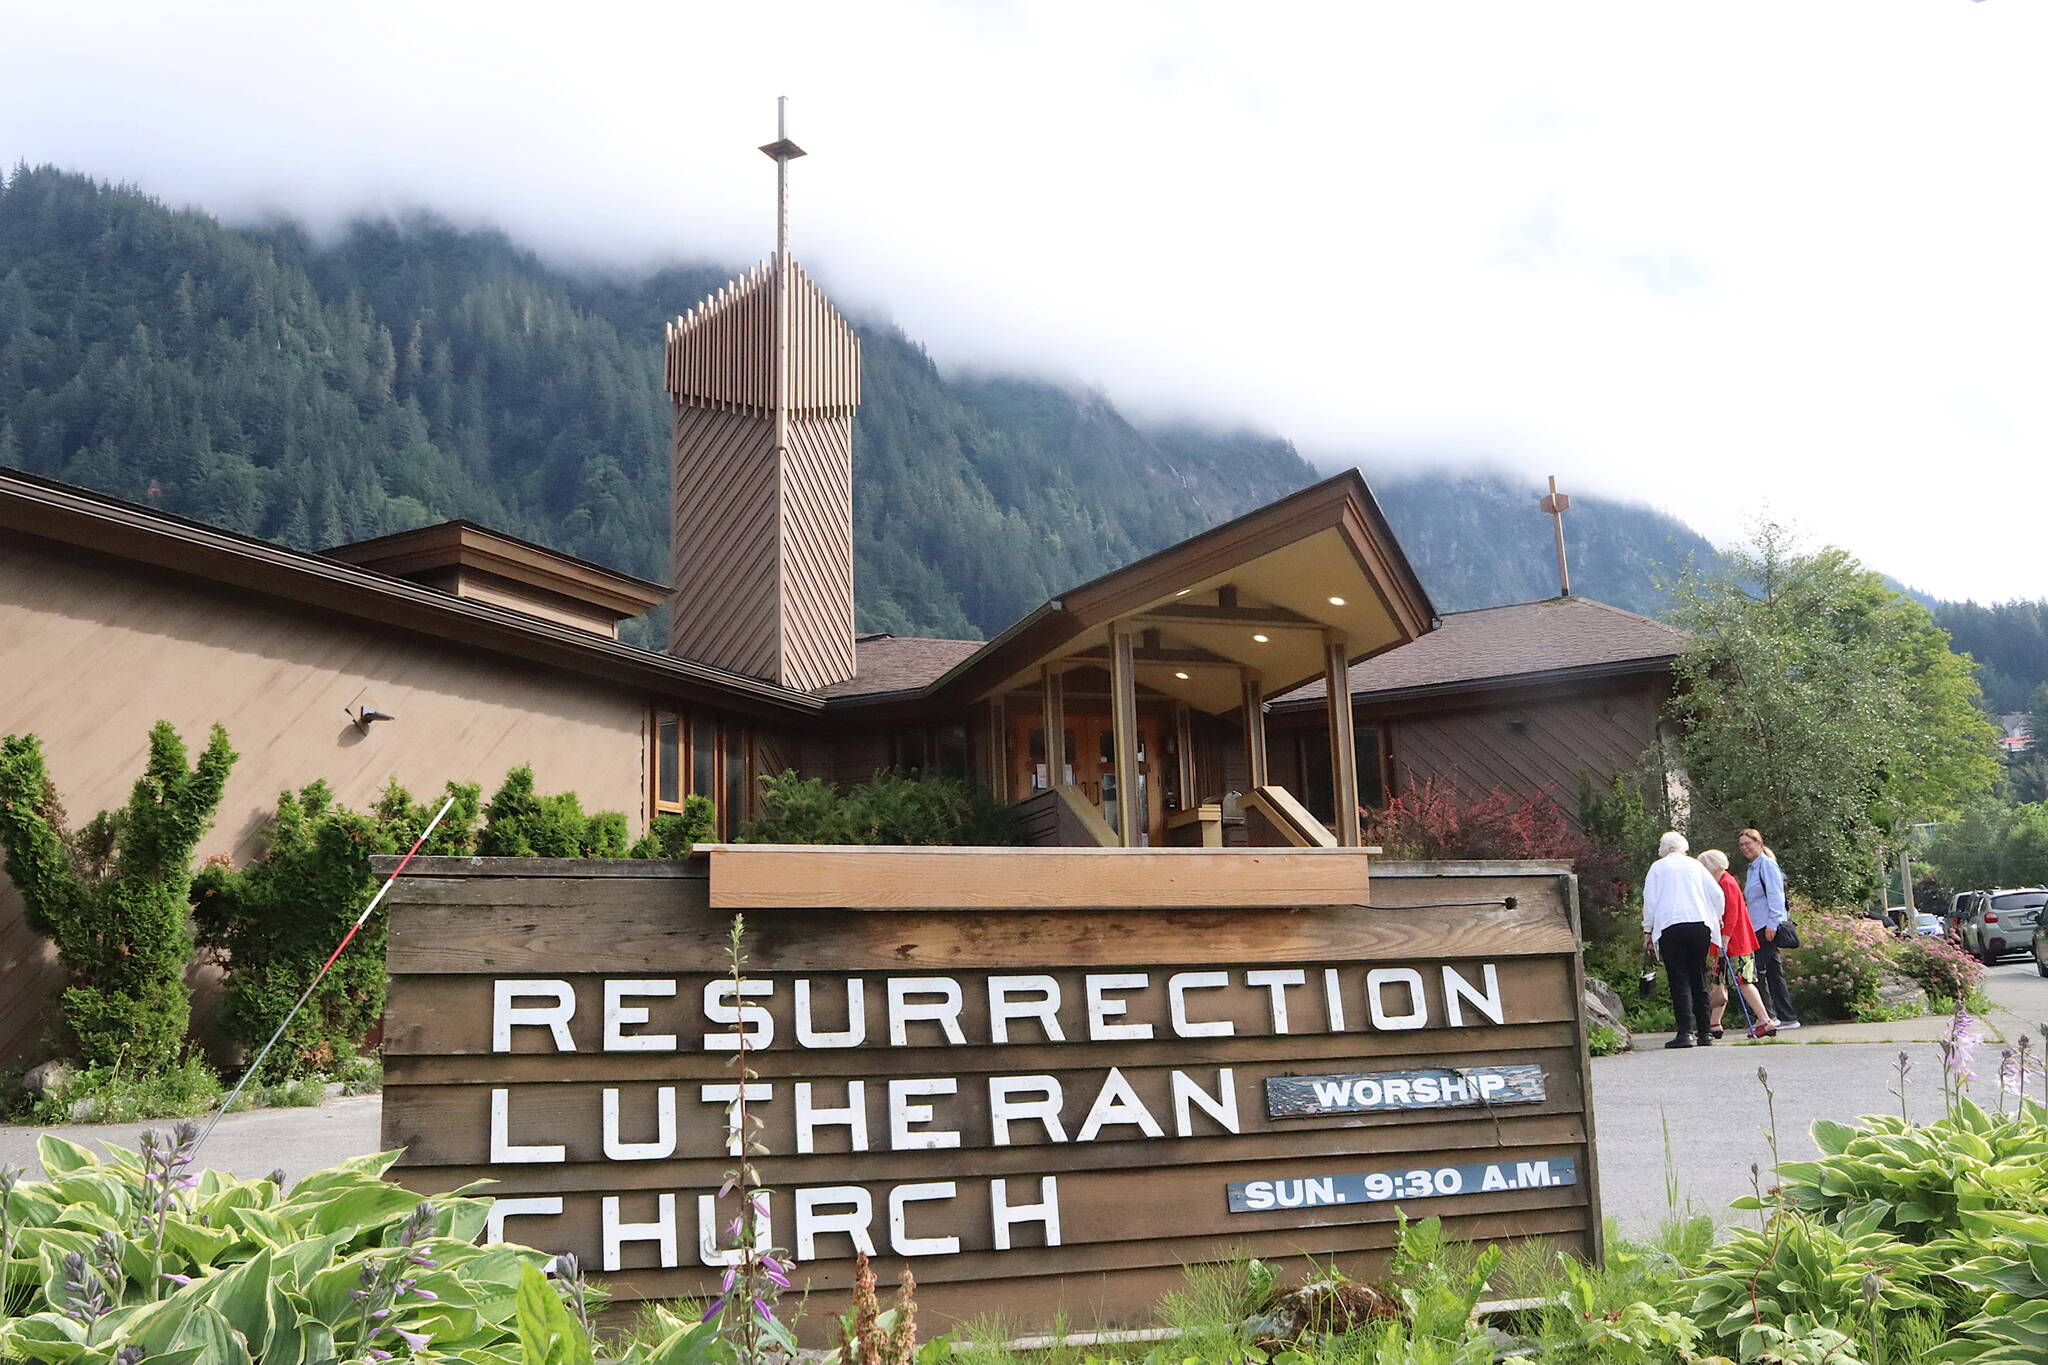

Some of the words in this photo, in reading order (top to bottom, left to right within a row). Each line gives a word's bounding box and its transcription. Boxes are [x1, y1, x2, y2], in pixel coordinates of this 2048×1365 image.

[492, 964, 1504, 1053] RESURRECTION
[490, 1067, 1240, 1164] LUTHERAN
[1312, 1074, 1506, 1108] WORSHIP
[1244, 1179, 1346, 1211] SUN.
[1364, 1167, 1463, 1199] 9:30
[1481, 1161, 1561, 1190] A.M.
